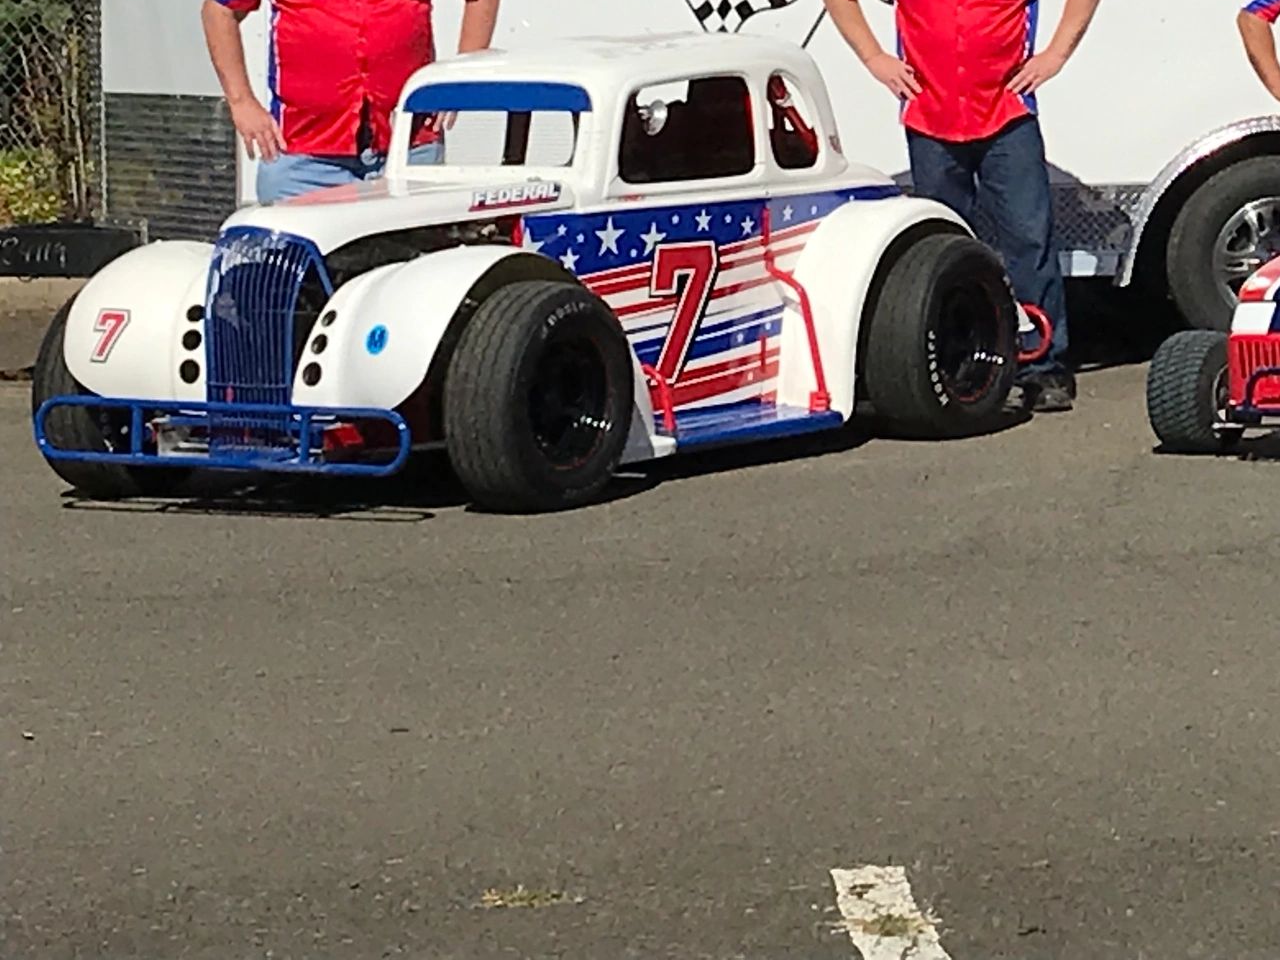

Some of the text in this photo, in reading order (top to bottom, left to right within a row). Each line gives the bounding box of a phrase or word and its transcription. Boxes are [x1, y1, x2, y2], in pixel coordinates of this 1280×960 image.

[473, 183, 561, 208] FEDERAL
[90, 308, 132, 363] 7
[646, 240, 719, 387] 7
